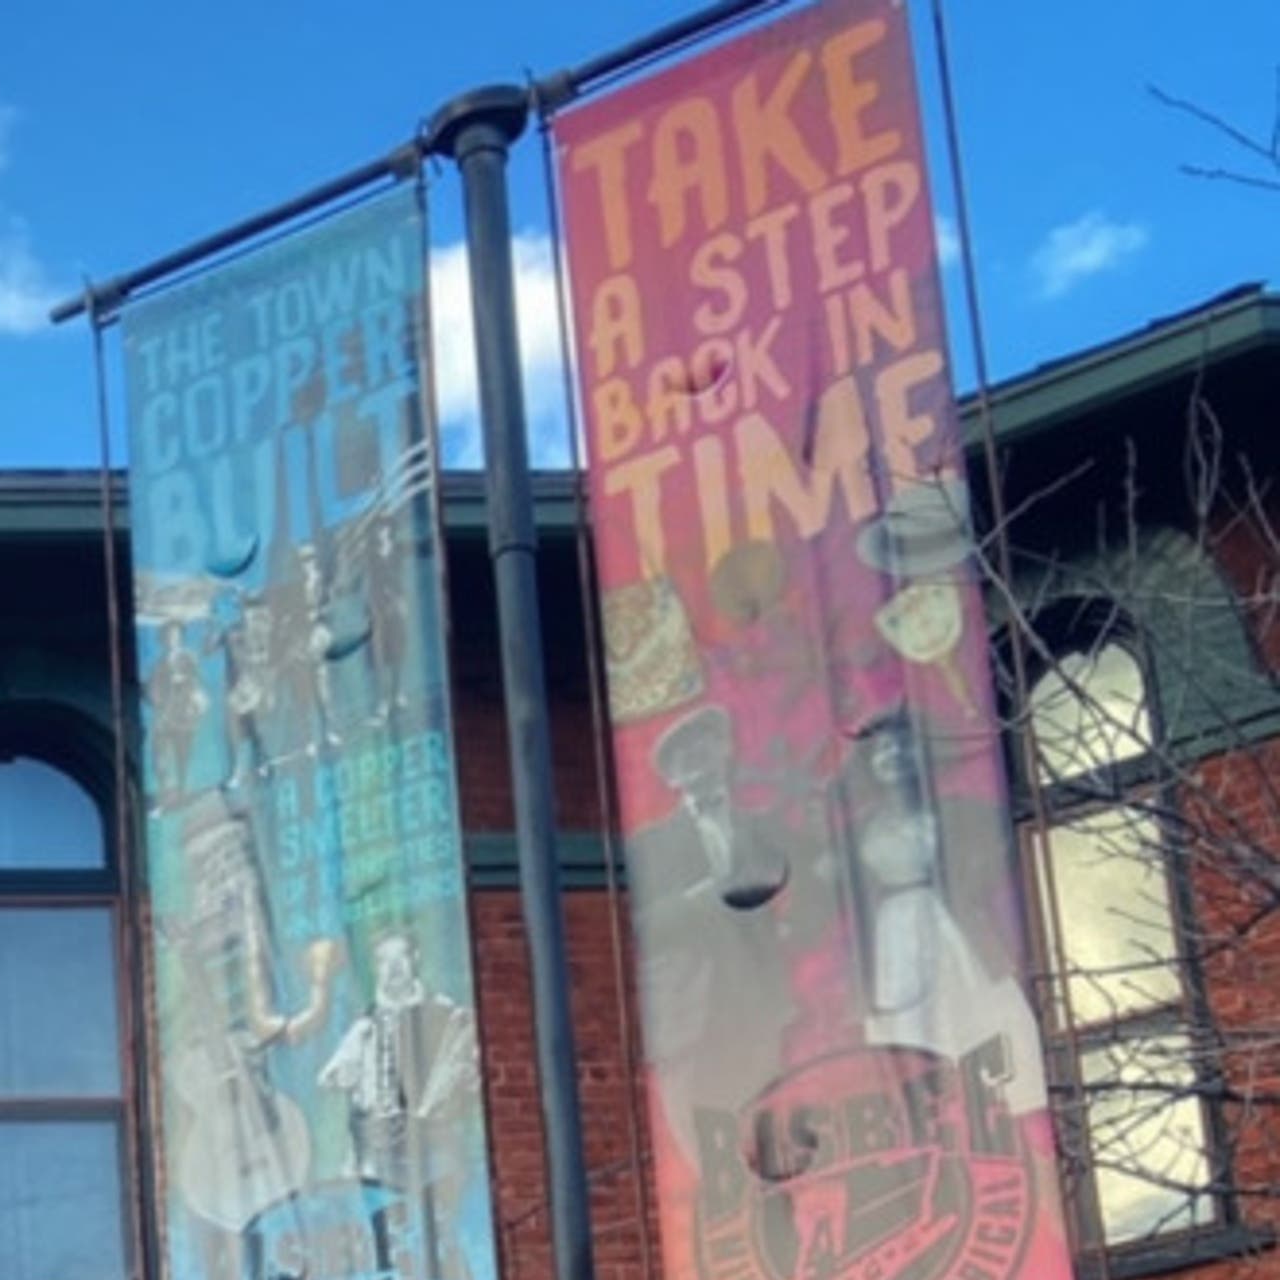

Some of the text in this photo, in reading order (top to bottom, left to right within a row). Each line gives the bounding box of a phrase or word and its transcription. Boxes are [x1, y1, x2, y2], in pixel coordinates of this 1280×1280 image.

[571, 19, 900, 270] TAKE
[140, 236, 405, 394] THE TOWN
[590, 160, 920, 380] A STEP
[592, 268, 916, 463] BACK IN
[145, 301, 415, 473] COPPER
[146, 377, 419, 592] BUILT
[604, 349, 944, 582] TIME
[693, 1032, 1015, 1221] BISBEE
